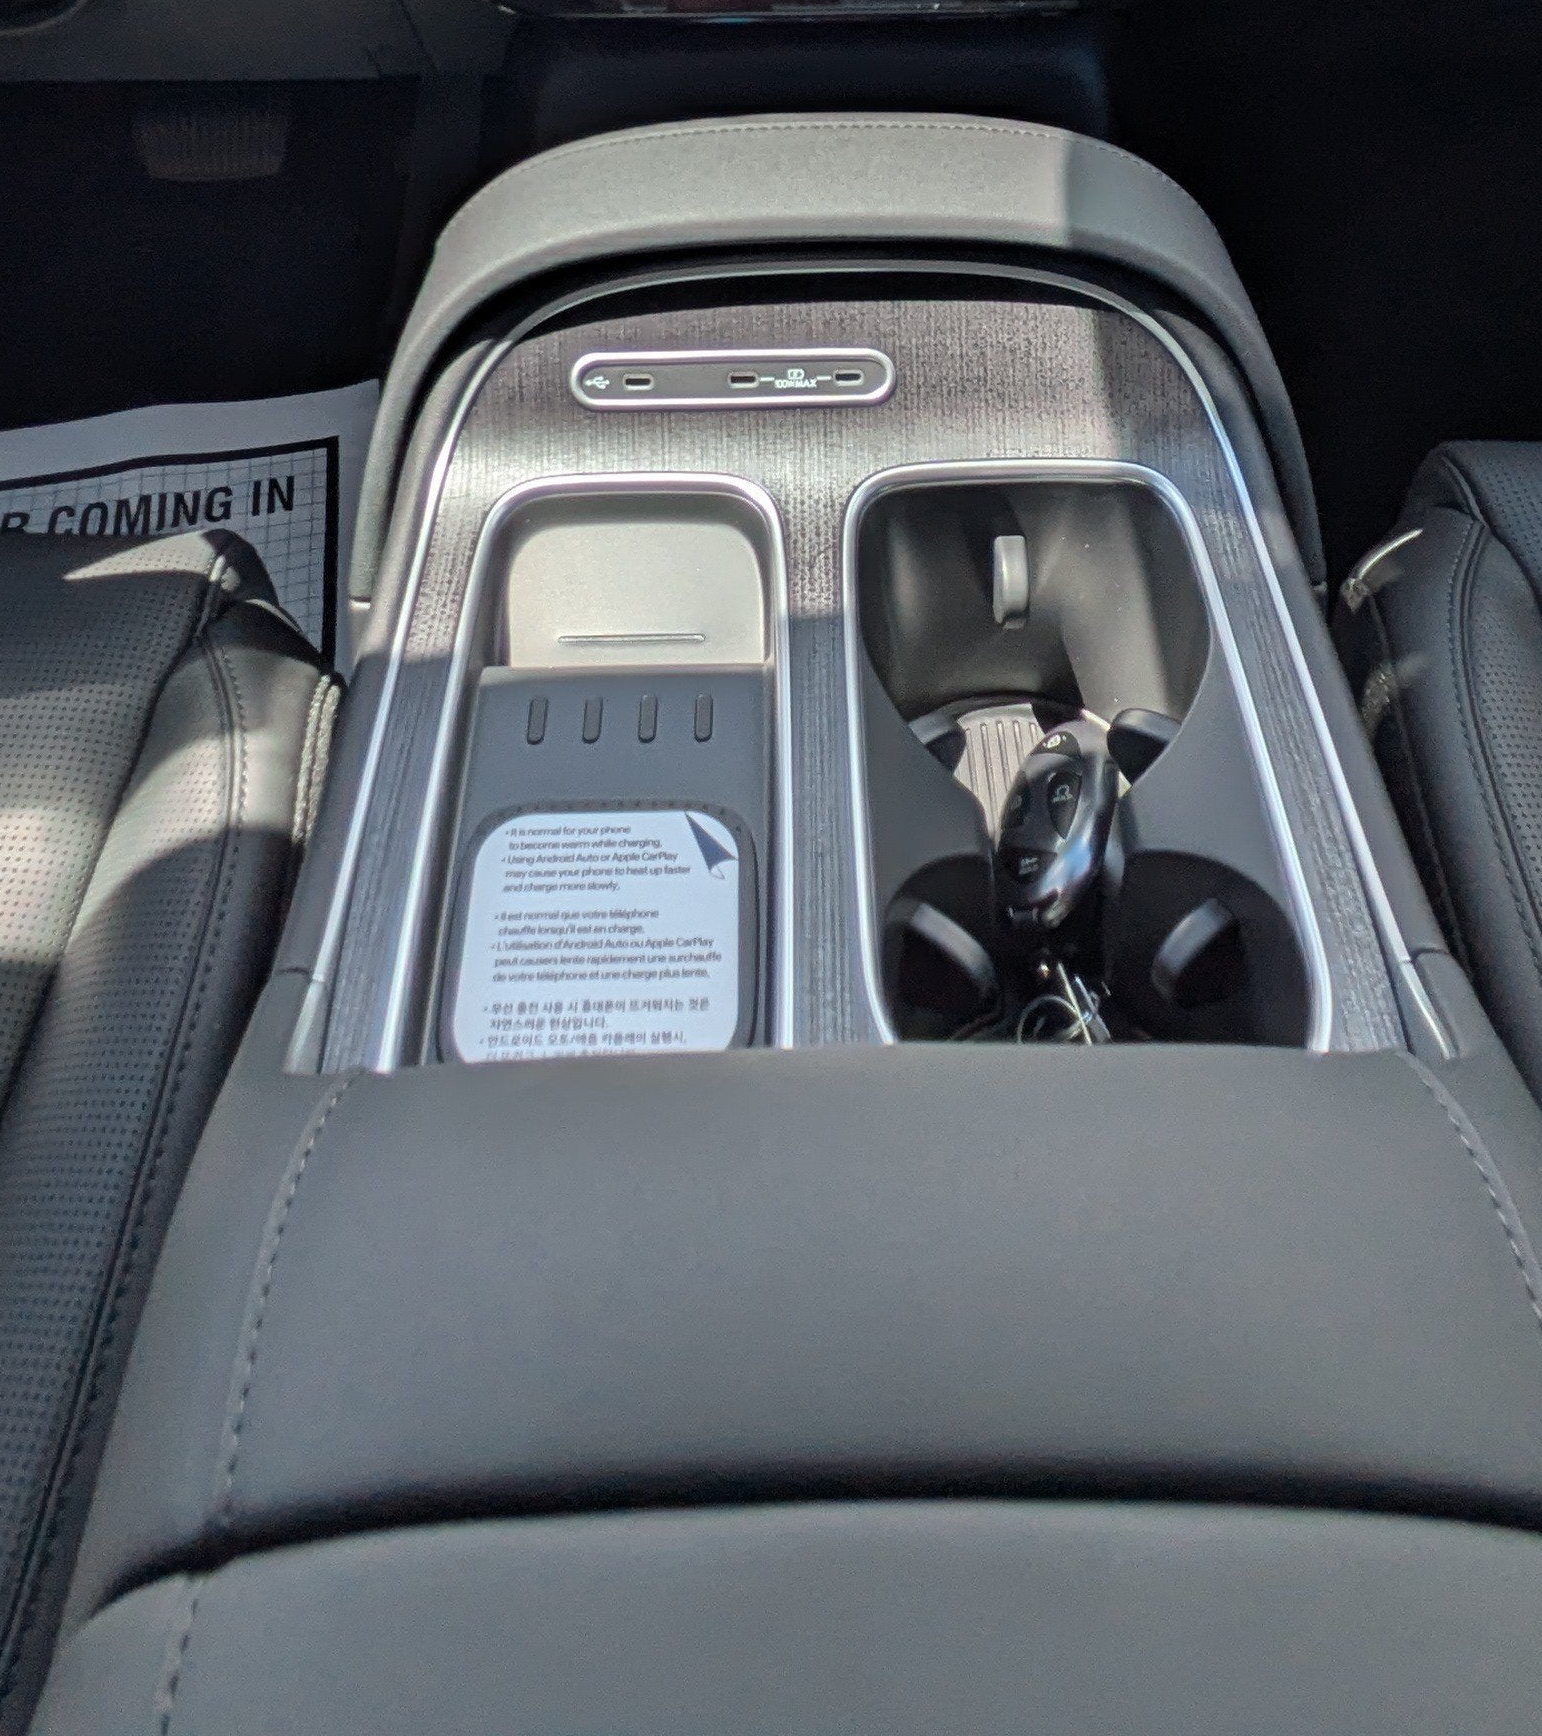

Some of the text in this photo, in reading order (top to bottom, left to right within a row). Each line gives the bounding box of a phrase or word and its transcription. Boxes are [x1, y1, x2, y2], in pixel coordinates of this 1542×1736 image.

[47, 485, 233, 535] COMING
[251, 475, 296, 516] IN
[528, 827, 561, 836] normal
[578, 827, 599, 837] your
[536, 854, 575, 864] Android
[576, 854, 599, 863] Auto
[612, 852, 640, 862] Apple
[642, 851, 678, 862] CarPlay
